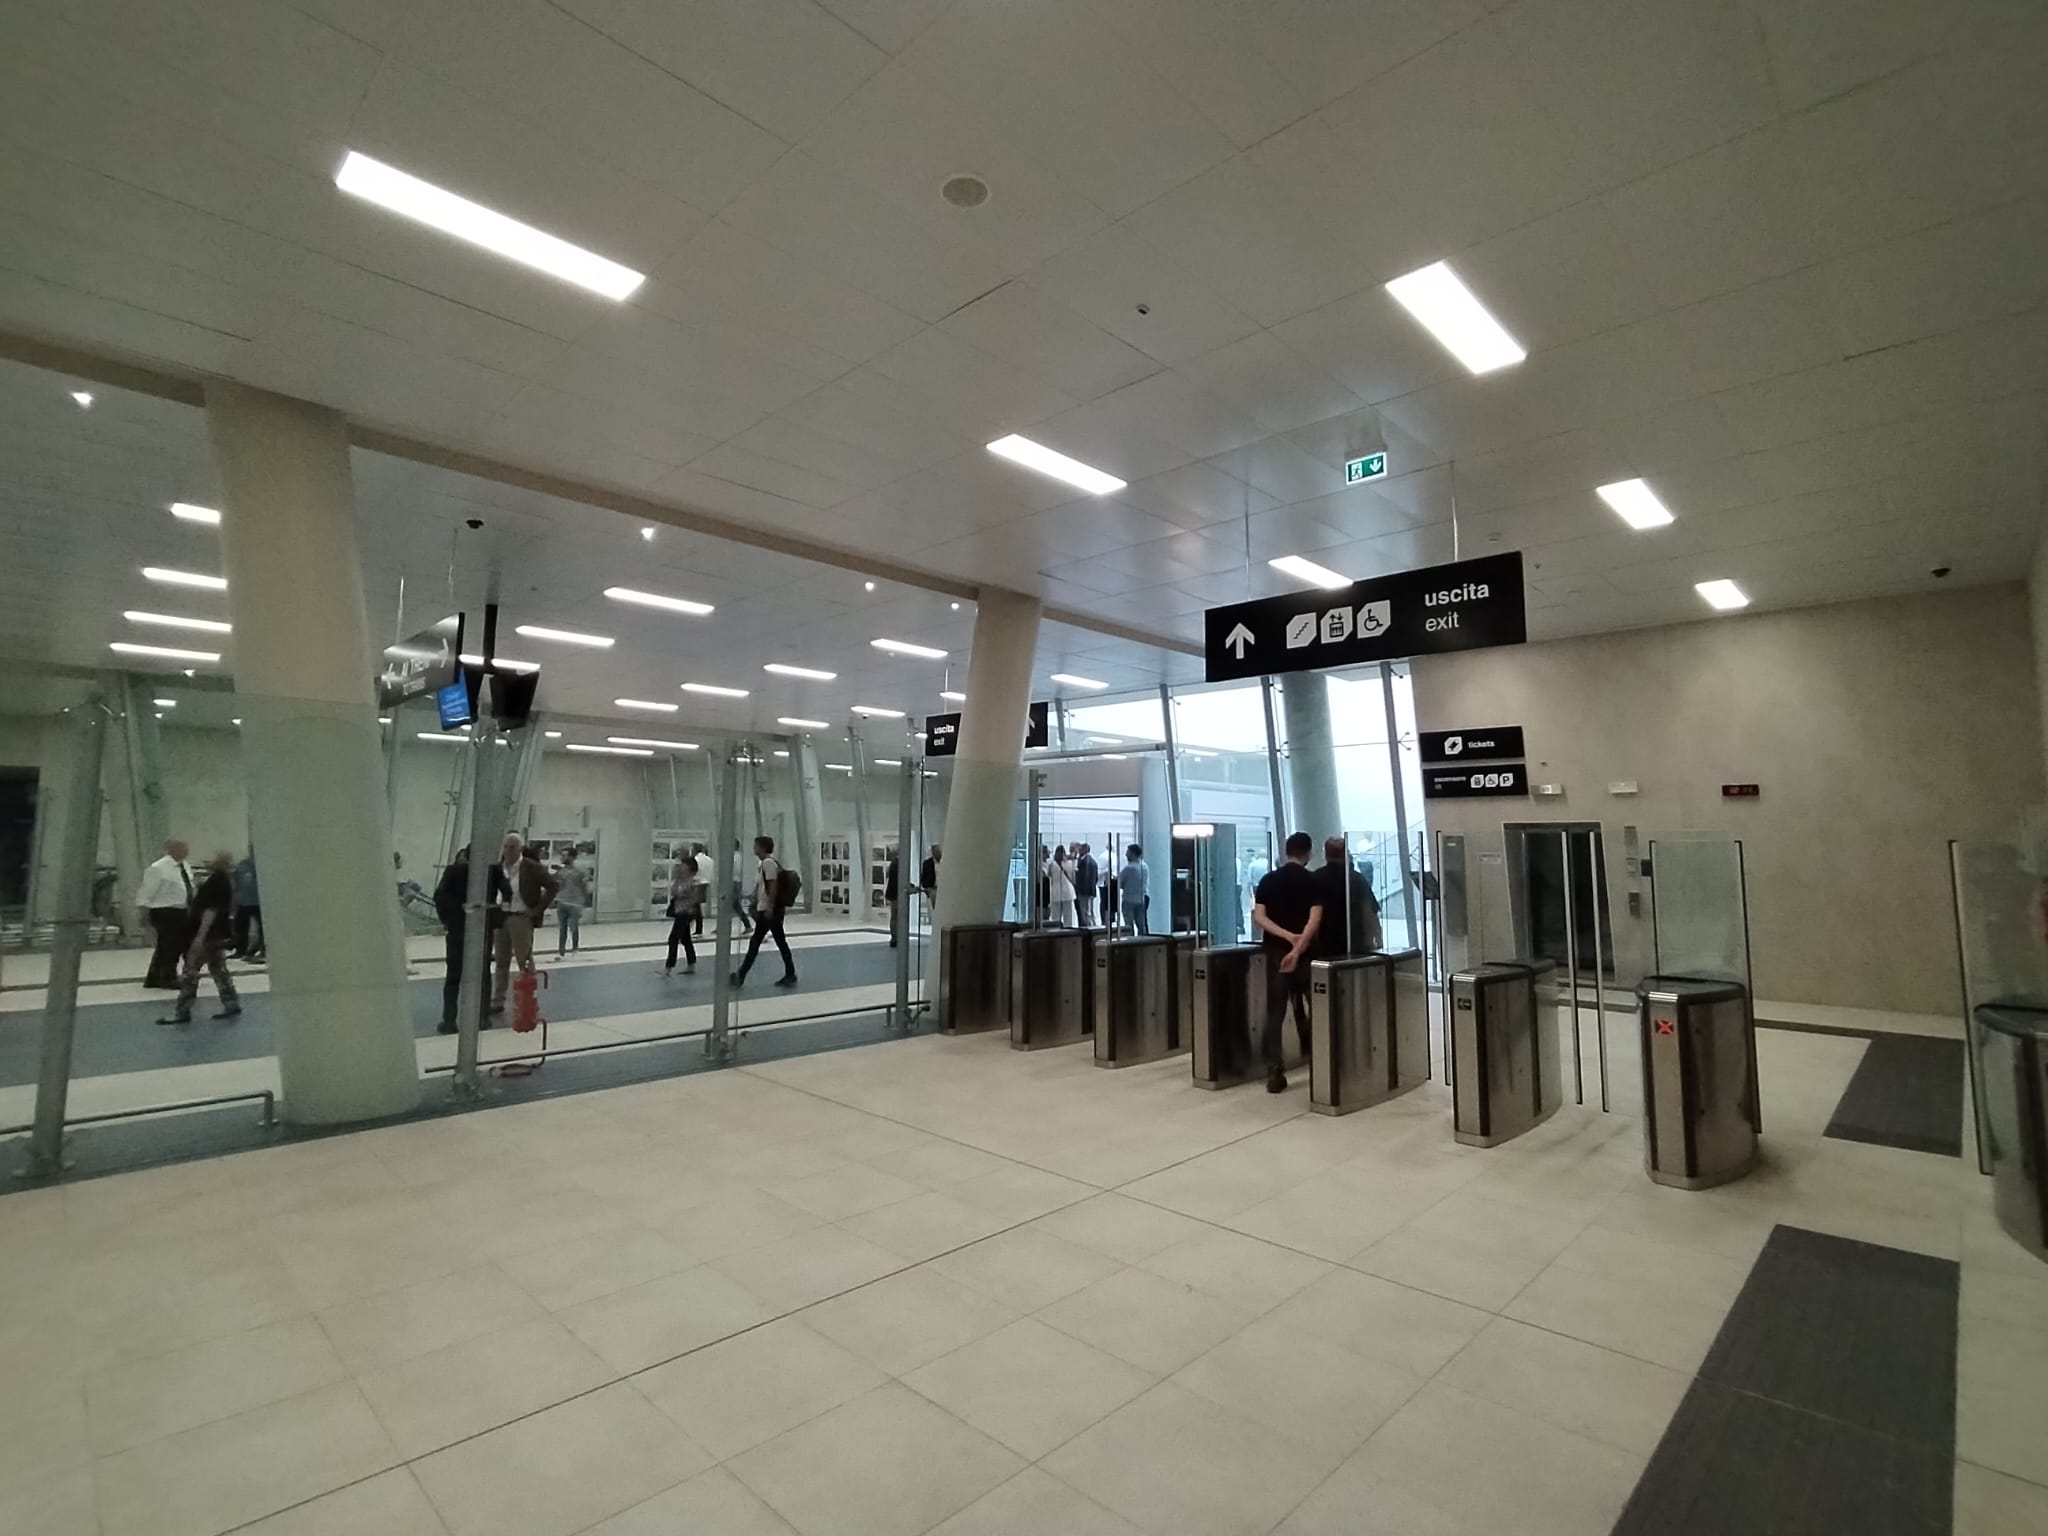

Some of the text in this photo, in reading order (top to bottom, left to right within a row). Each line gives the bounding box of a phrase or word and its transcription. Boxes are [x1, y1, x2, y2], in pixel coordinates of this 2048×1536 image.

[1424, 583, 1489, 607] uscita
[1425, 611, 1460, 632] exit
[933, 724, 955, 735] uscita
[1468, 740, 1495, 748] tickets
